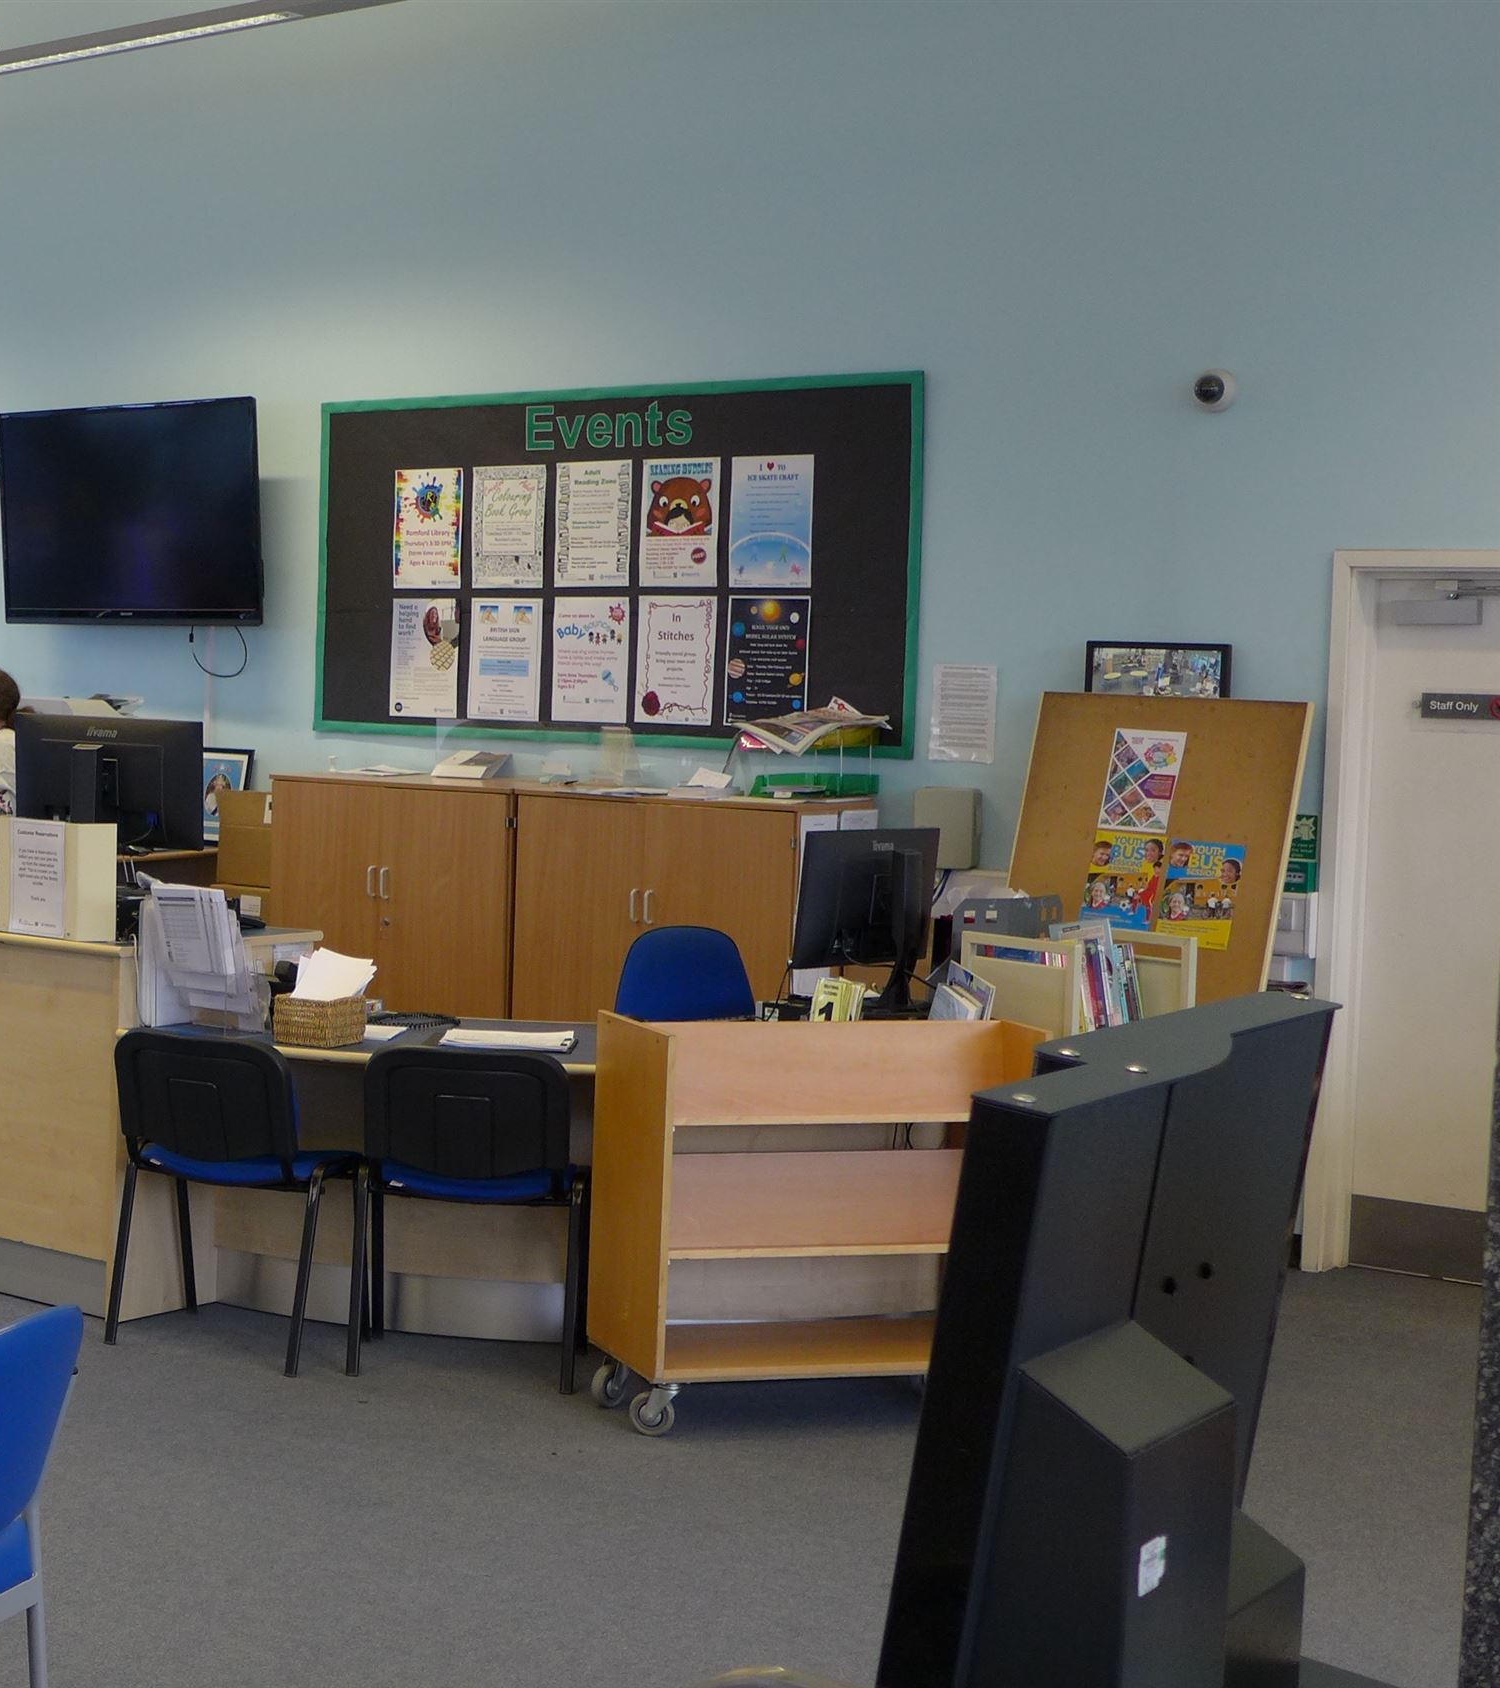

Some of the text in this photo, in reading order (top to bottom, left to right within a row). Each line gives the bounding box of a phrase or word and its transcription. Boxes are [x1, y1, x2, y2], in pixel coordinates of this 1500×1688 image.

[525, 401, 693, 451] Events
[492, 488, 532, 506] Colouring
[484, 502, 533, 520] Book Group
[406, 528, 450, 538] Romford Library
[672, 612, 682, 623] In
[556, 623, 587, 640] Baby
[657, 630, 695, 641] Stitches
[1429, 700, 1479, 713] Staff Only
[1114, 834, 1147, 848] YOUTH
[1110, 844, 1146, 861] BUS
[1191, 844, 1226, 857] YOUTH
[1188, 854, 1224, 870] BUS
[817, 1000, 835, 1021] 1
